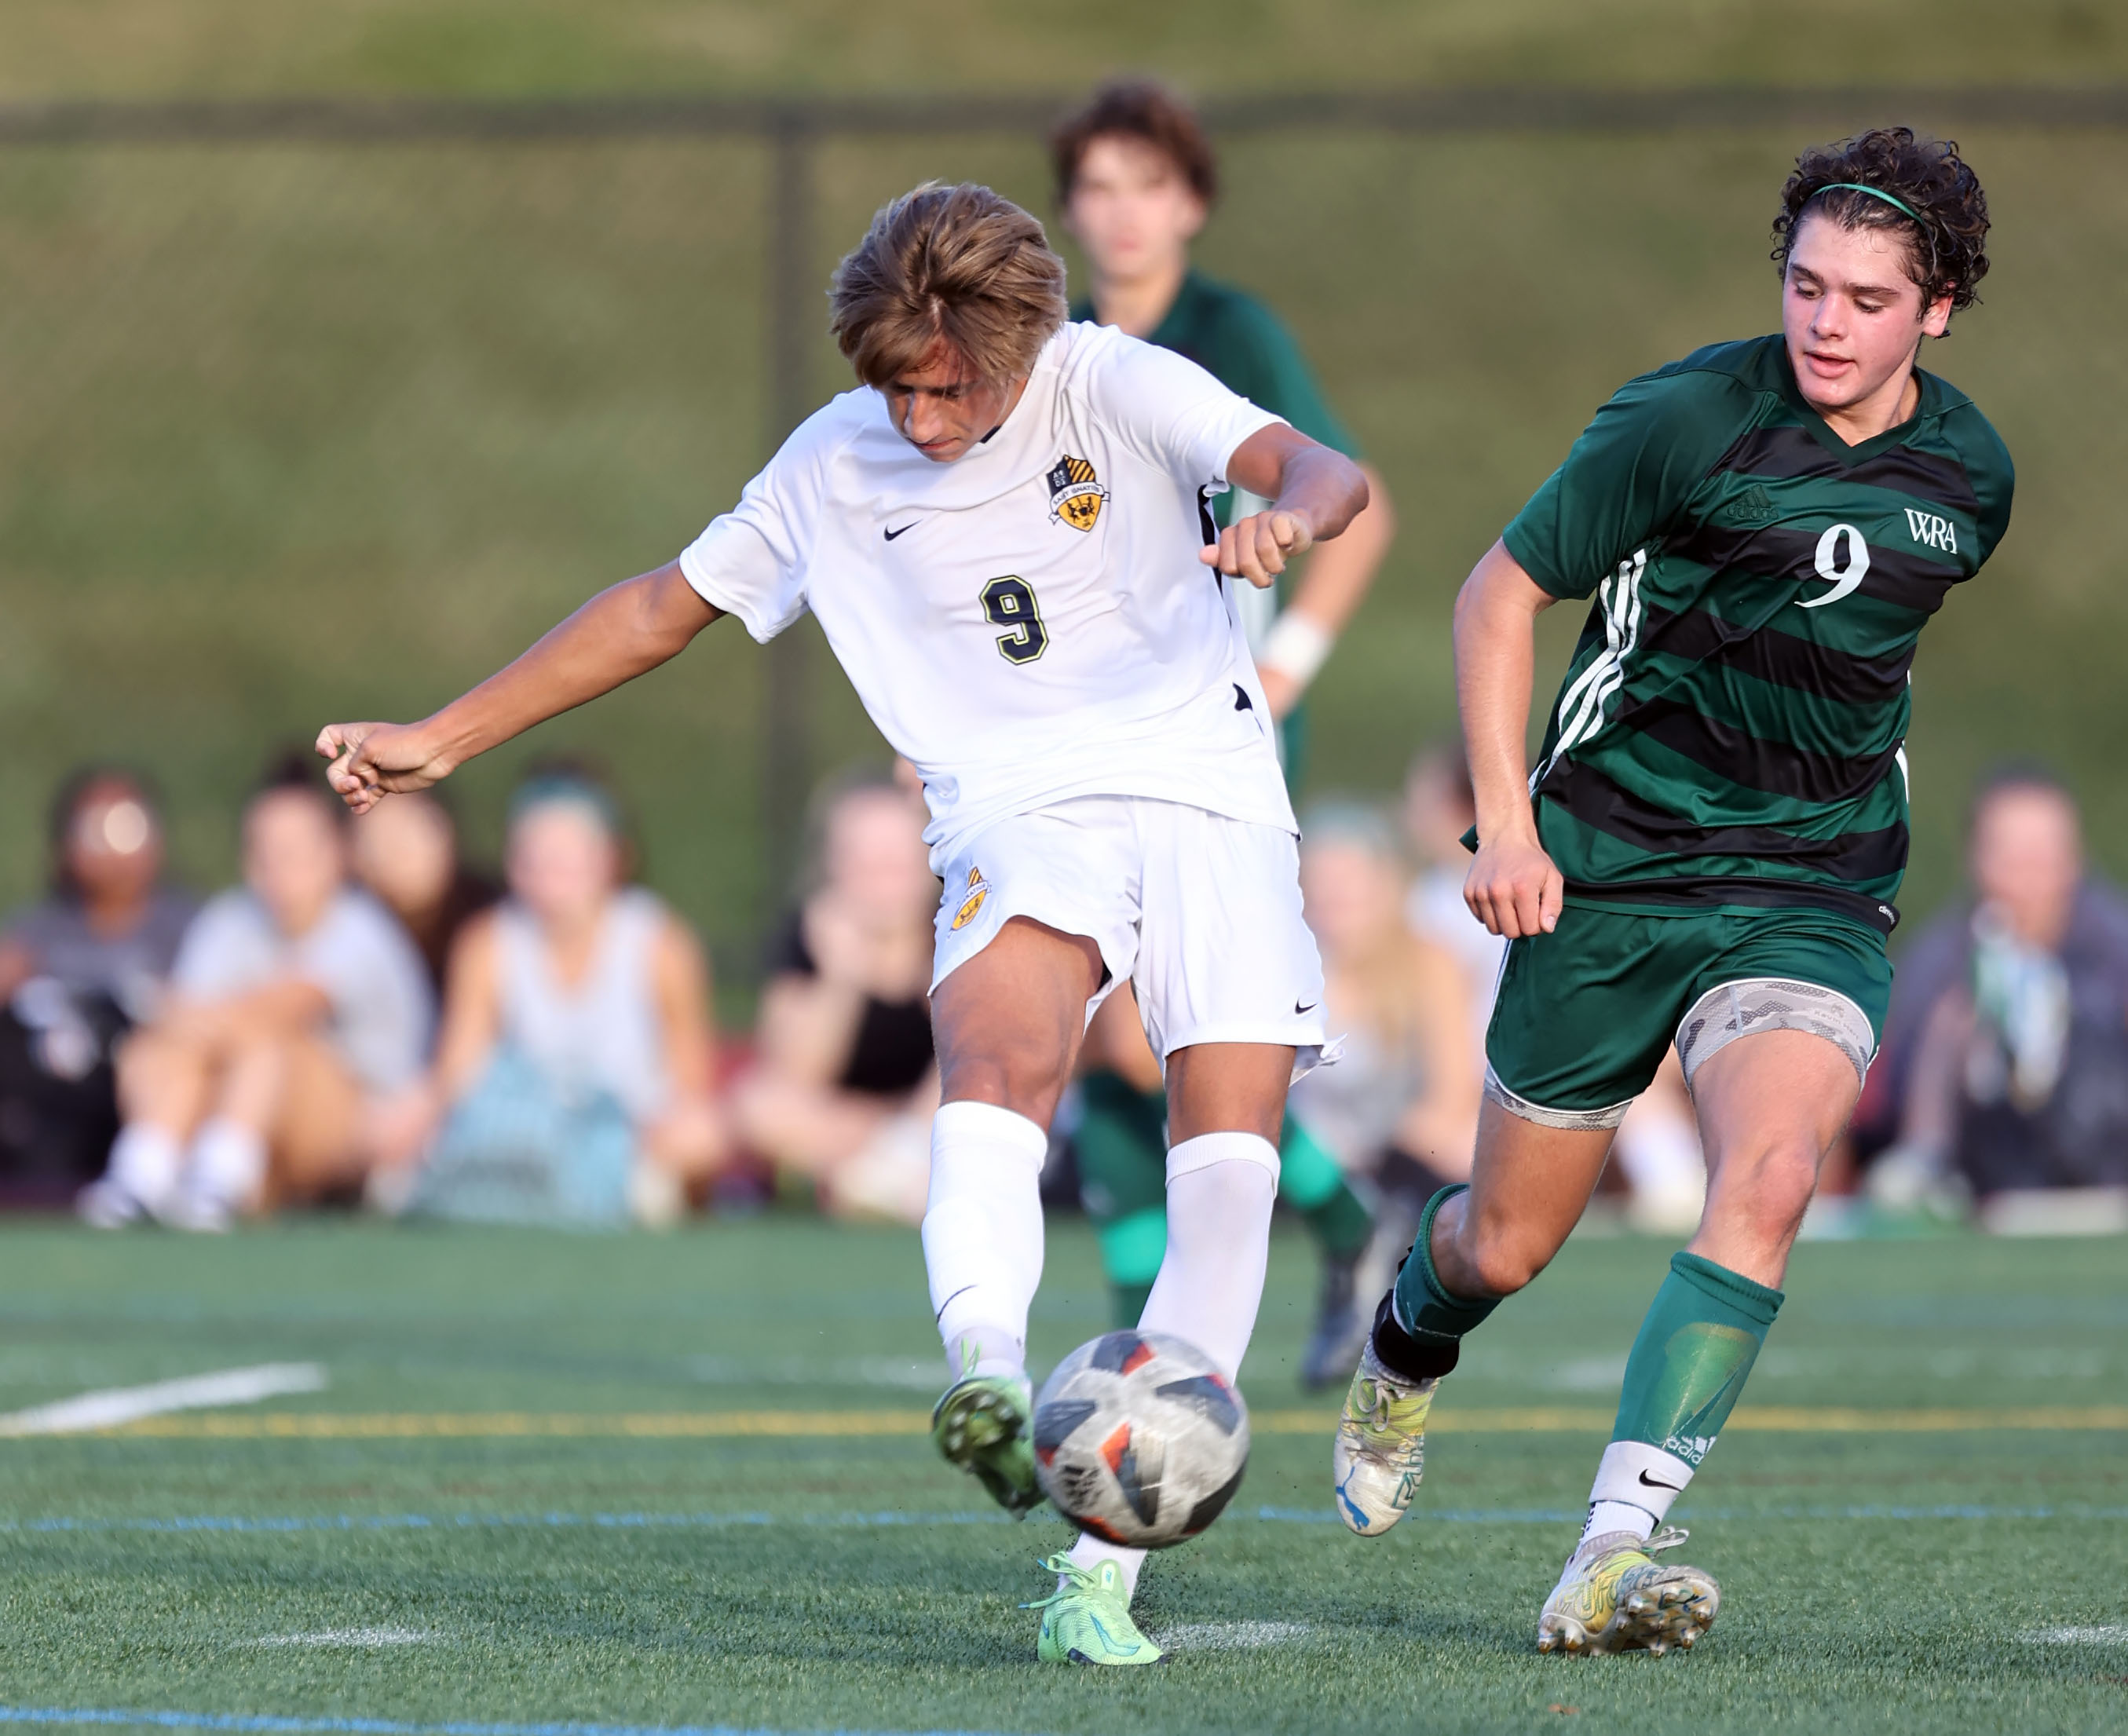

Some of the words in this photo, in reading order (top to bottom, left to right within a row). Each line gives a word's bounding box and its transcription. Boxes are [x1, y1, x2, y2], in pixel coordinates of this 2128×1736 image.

[1903, 508, 1958, 555] WRA
[1793, 523, 1870, 608] 9
[978, 575, 1049, 666] 9
[1665, 1434, 1705, 1465] adid
